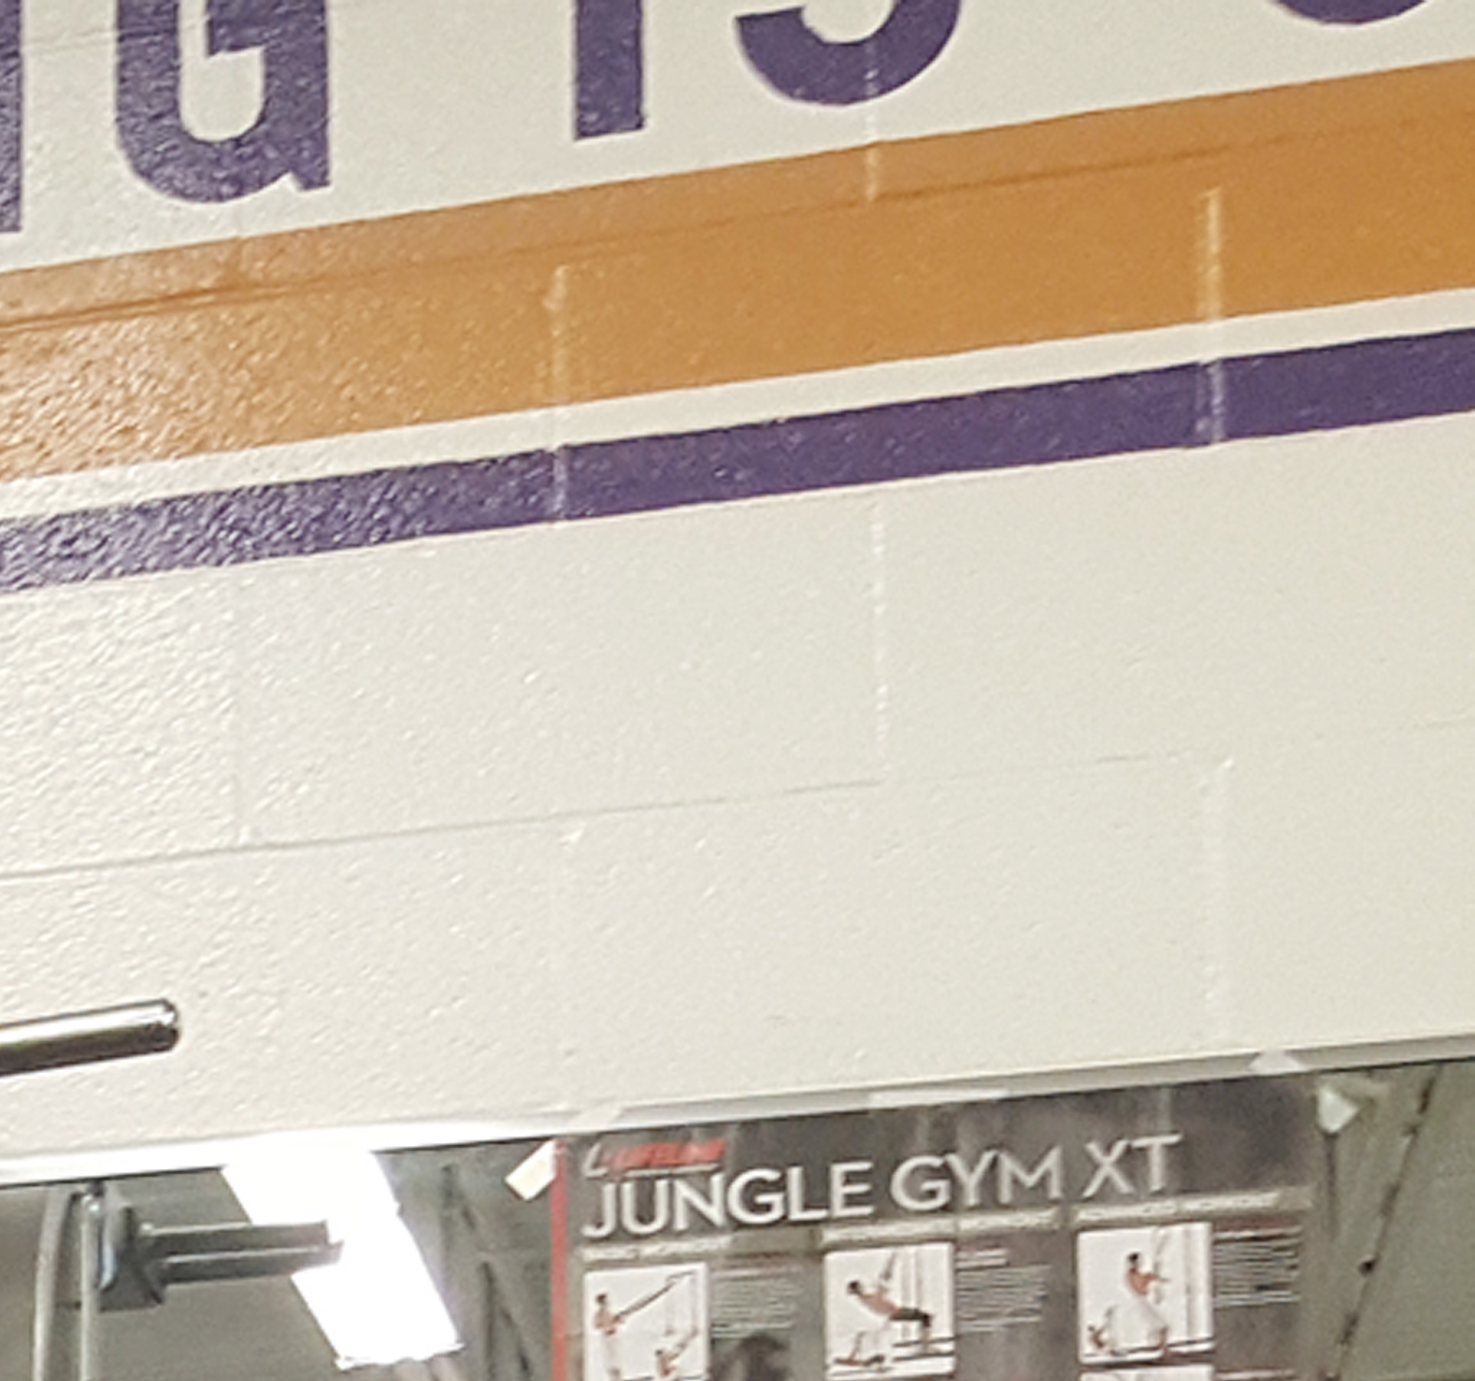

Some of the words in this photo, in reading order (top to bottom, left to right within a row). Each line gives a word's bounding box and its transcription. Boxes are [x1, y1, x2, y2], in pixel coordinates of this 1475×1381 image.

[580, 1160, 873, 1239] JUNGLE
[890, 1154, 1064, 1212] GYM
[1081, 1134, 1184, 1199] XT
